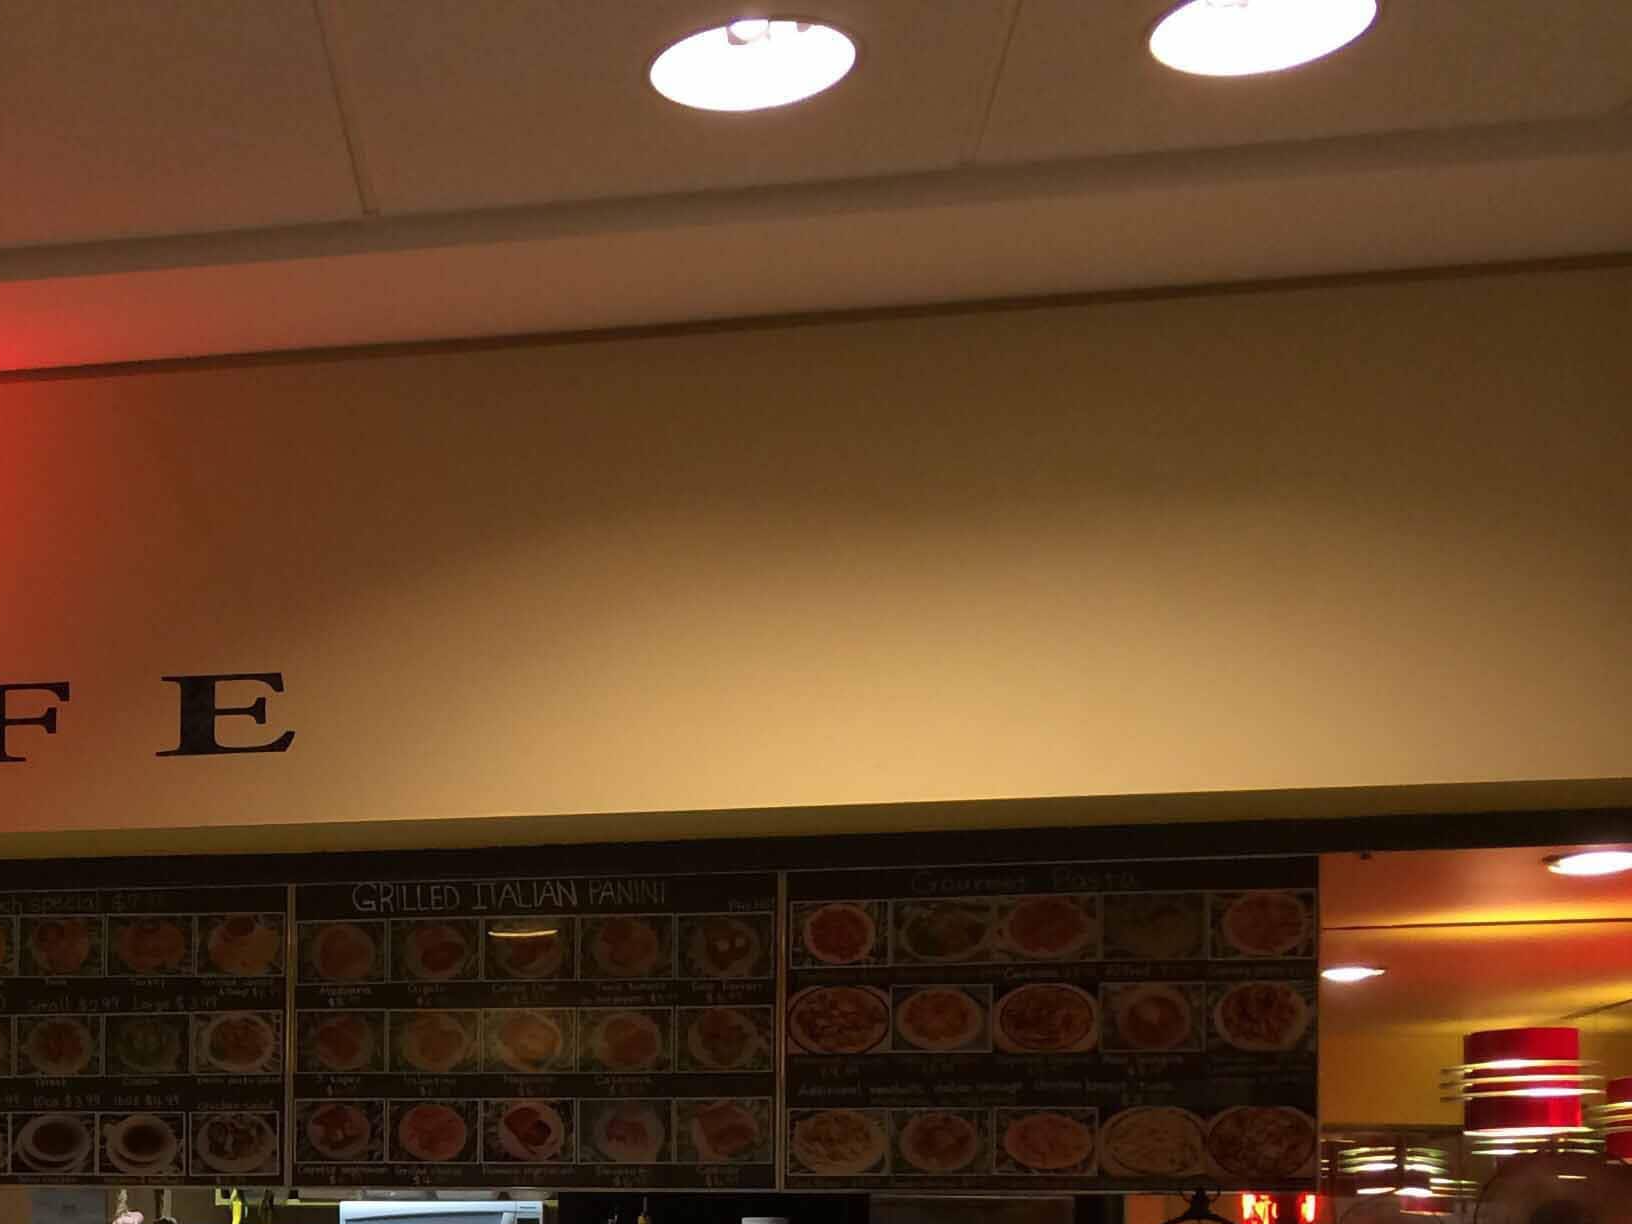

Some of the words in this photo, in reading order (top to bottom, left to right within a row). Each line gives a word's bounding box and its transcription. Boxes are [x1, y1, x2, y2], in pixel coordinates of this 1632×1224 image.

[352, 881, 461, 912] GRILLED
[472, 880, 578, 910] ITALIAN
[588, 878, 666, 906] PANINI
